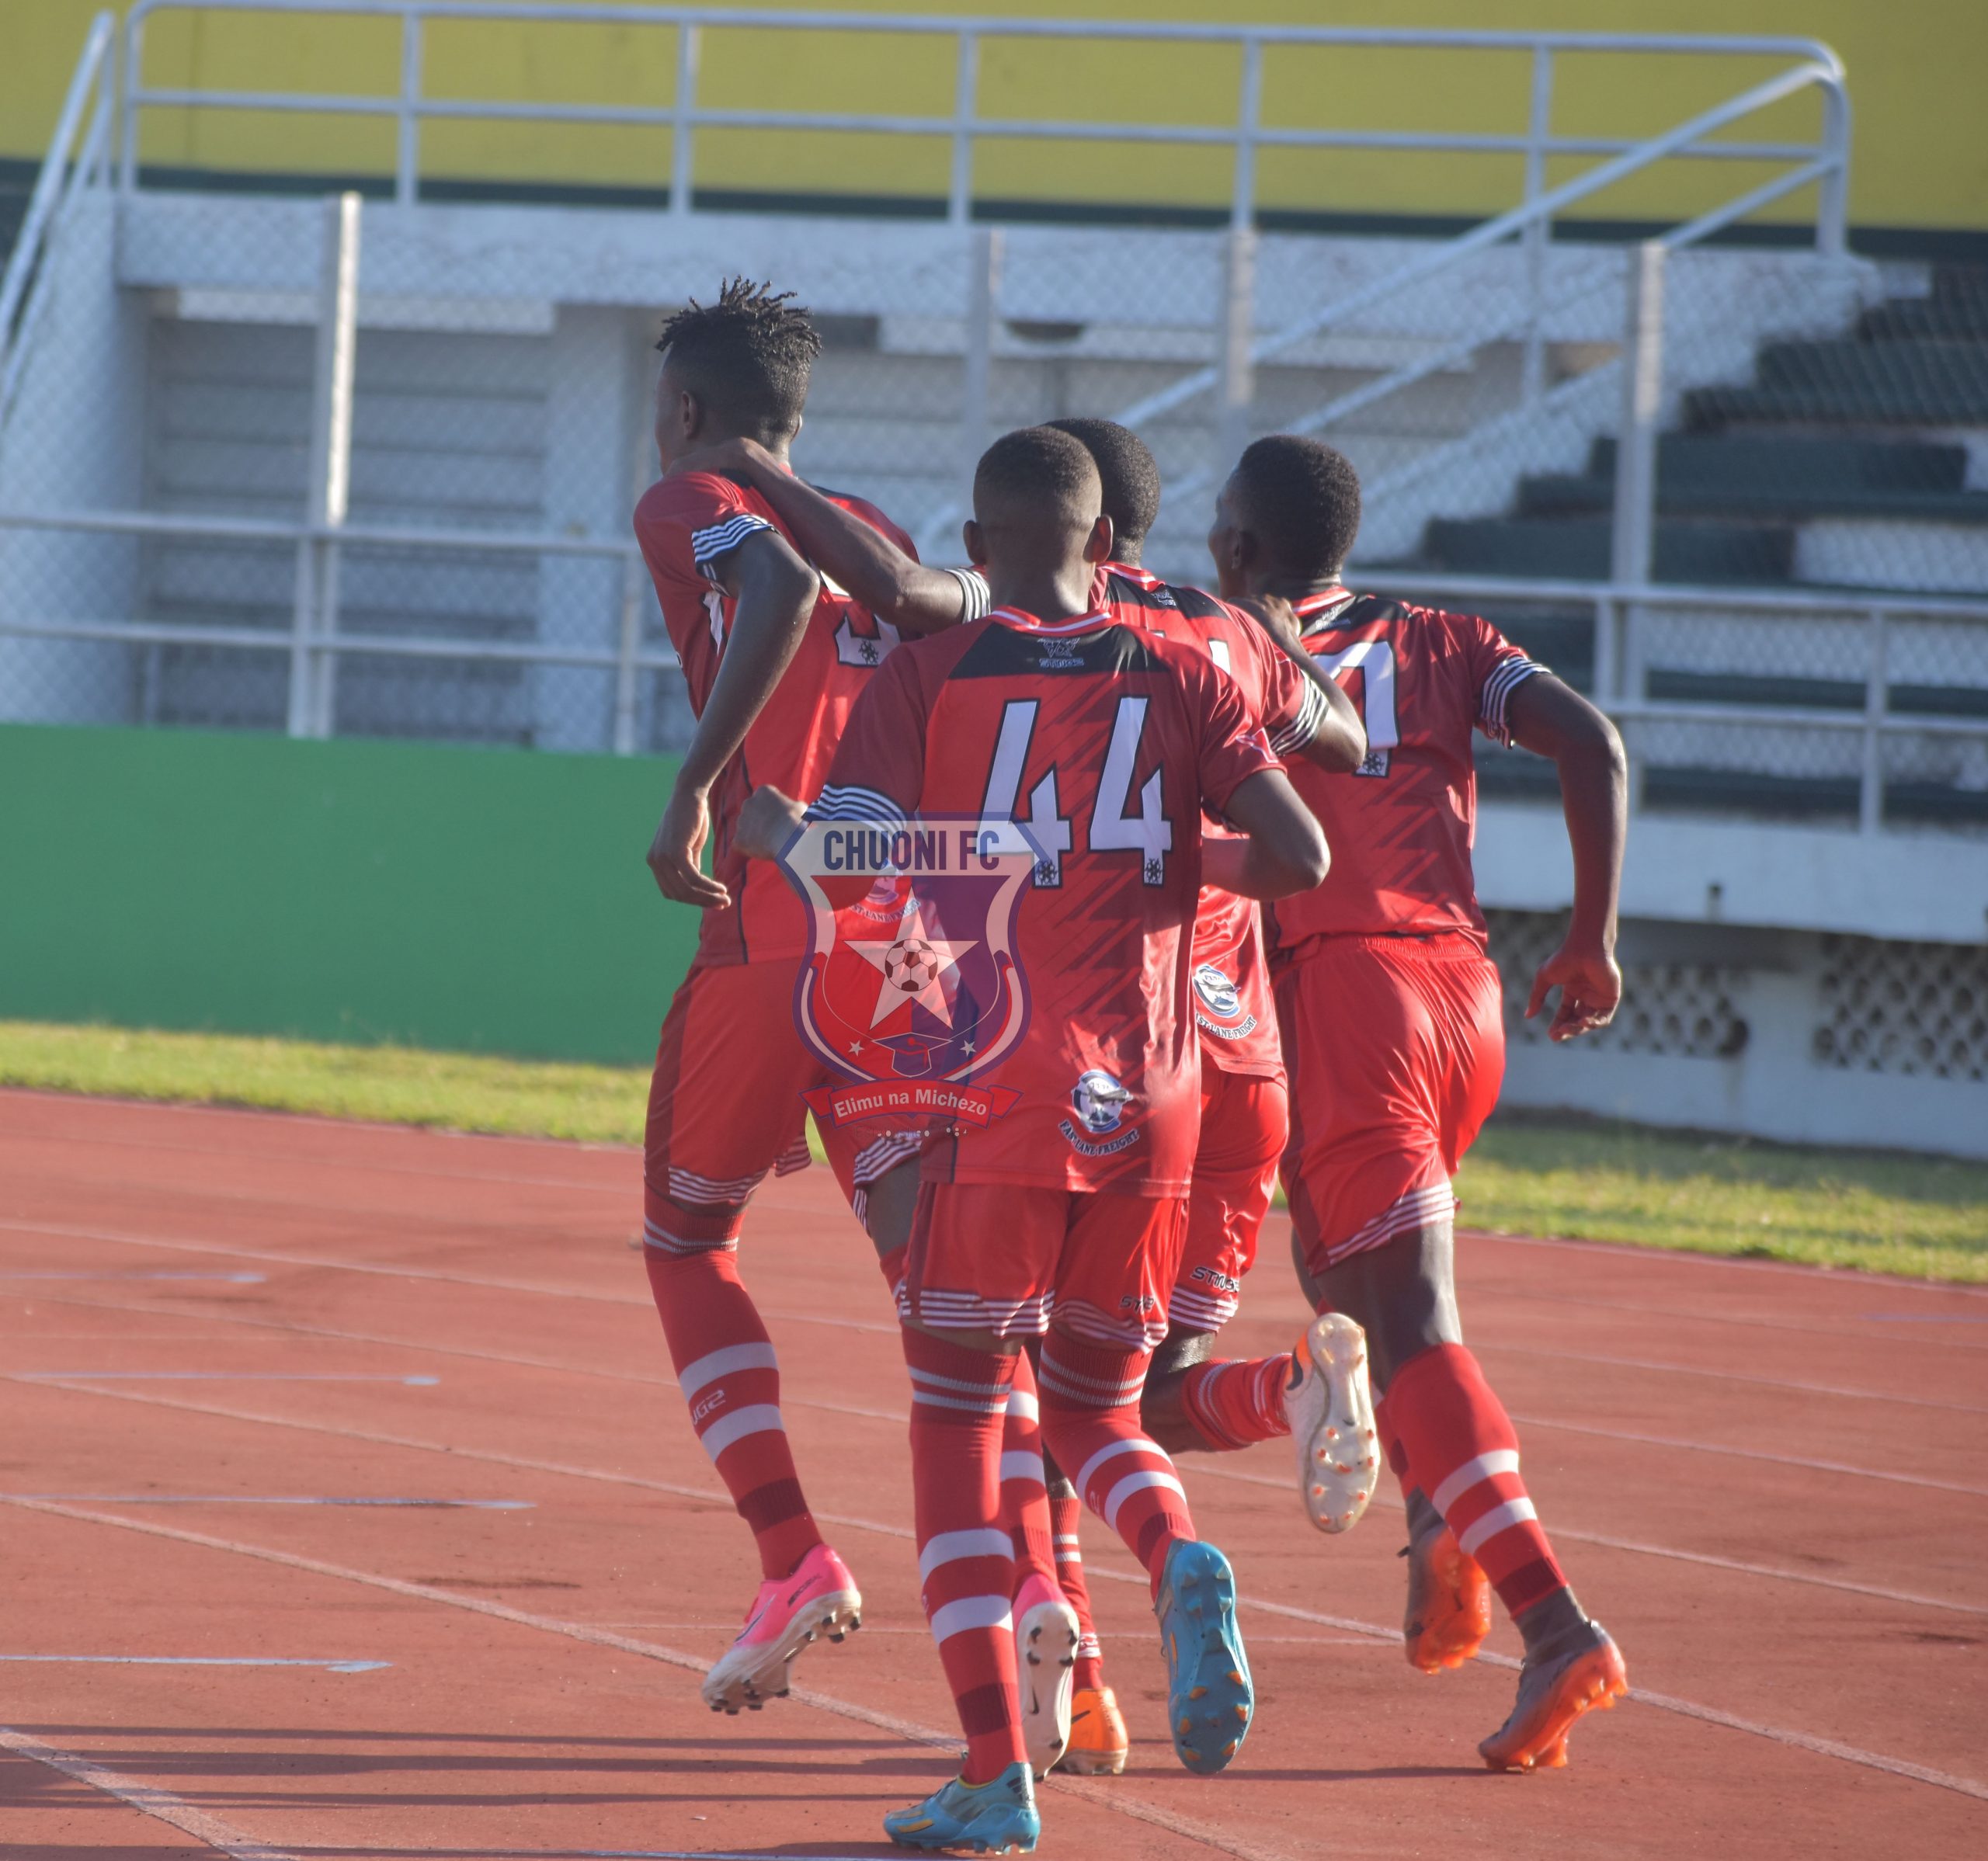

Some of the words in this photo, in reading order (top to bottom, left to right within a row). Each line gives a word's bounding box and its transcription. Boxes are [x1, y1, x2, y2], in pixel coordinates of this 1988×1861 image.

[976, 696, 1172, 889] 44
[1209, 1024, 1233, 1039] LANE
[1232, 1015, 1257, 1040] FREIGHT
[1074, 1139, 1097, 1156] LANE
[1096, 1128, 1139, 1156] FREIGHT
